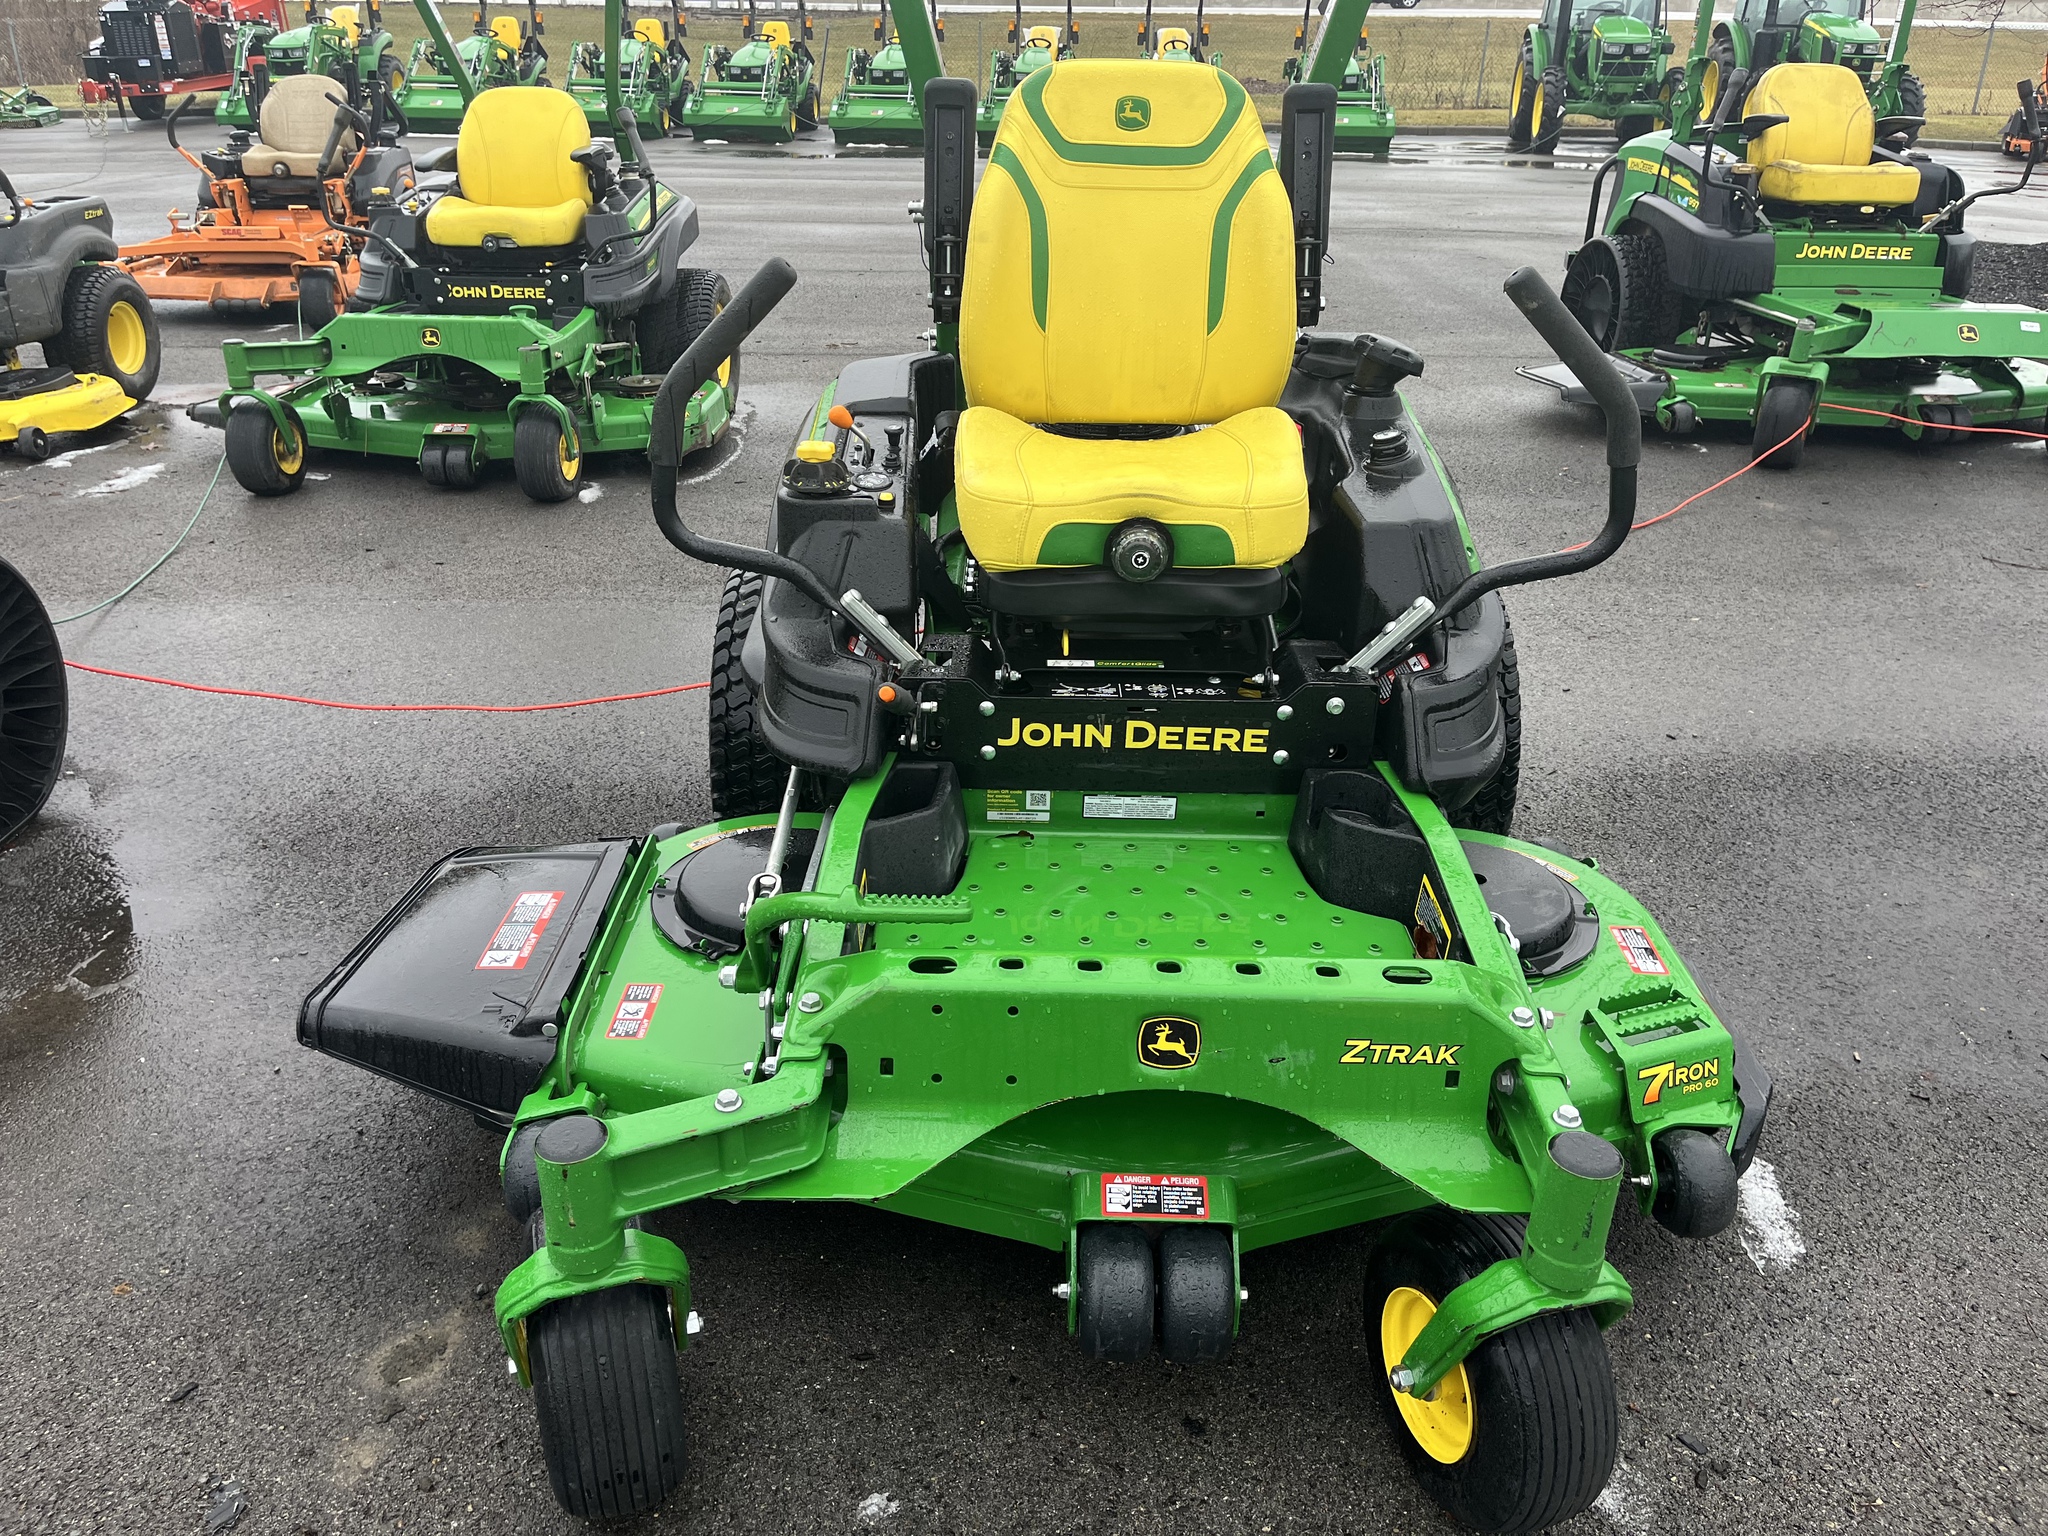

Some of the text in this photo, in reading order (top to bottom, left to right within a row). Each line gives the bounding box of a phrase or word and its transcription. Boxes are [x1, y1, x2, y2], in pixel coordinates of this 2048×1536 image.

[1795, 242, 1914, 260] JOHN DEERE
[490, 284, 546, 299] DEERE
[997, 717, 1270, 752] JOHN DEERE
[1339, 1039, 1463, 1065] ZTRAK
[1682, 1077, 1719, 1095] PRO 60
[1123, 1175, 1200, 1185] DANGER PELIGRO
